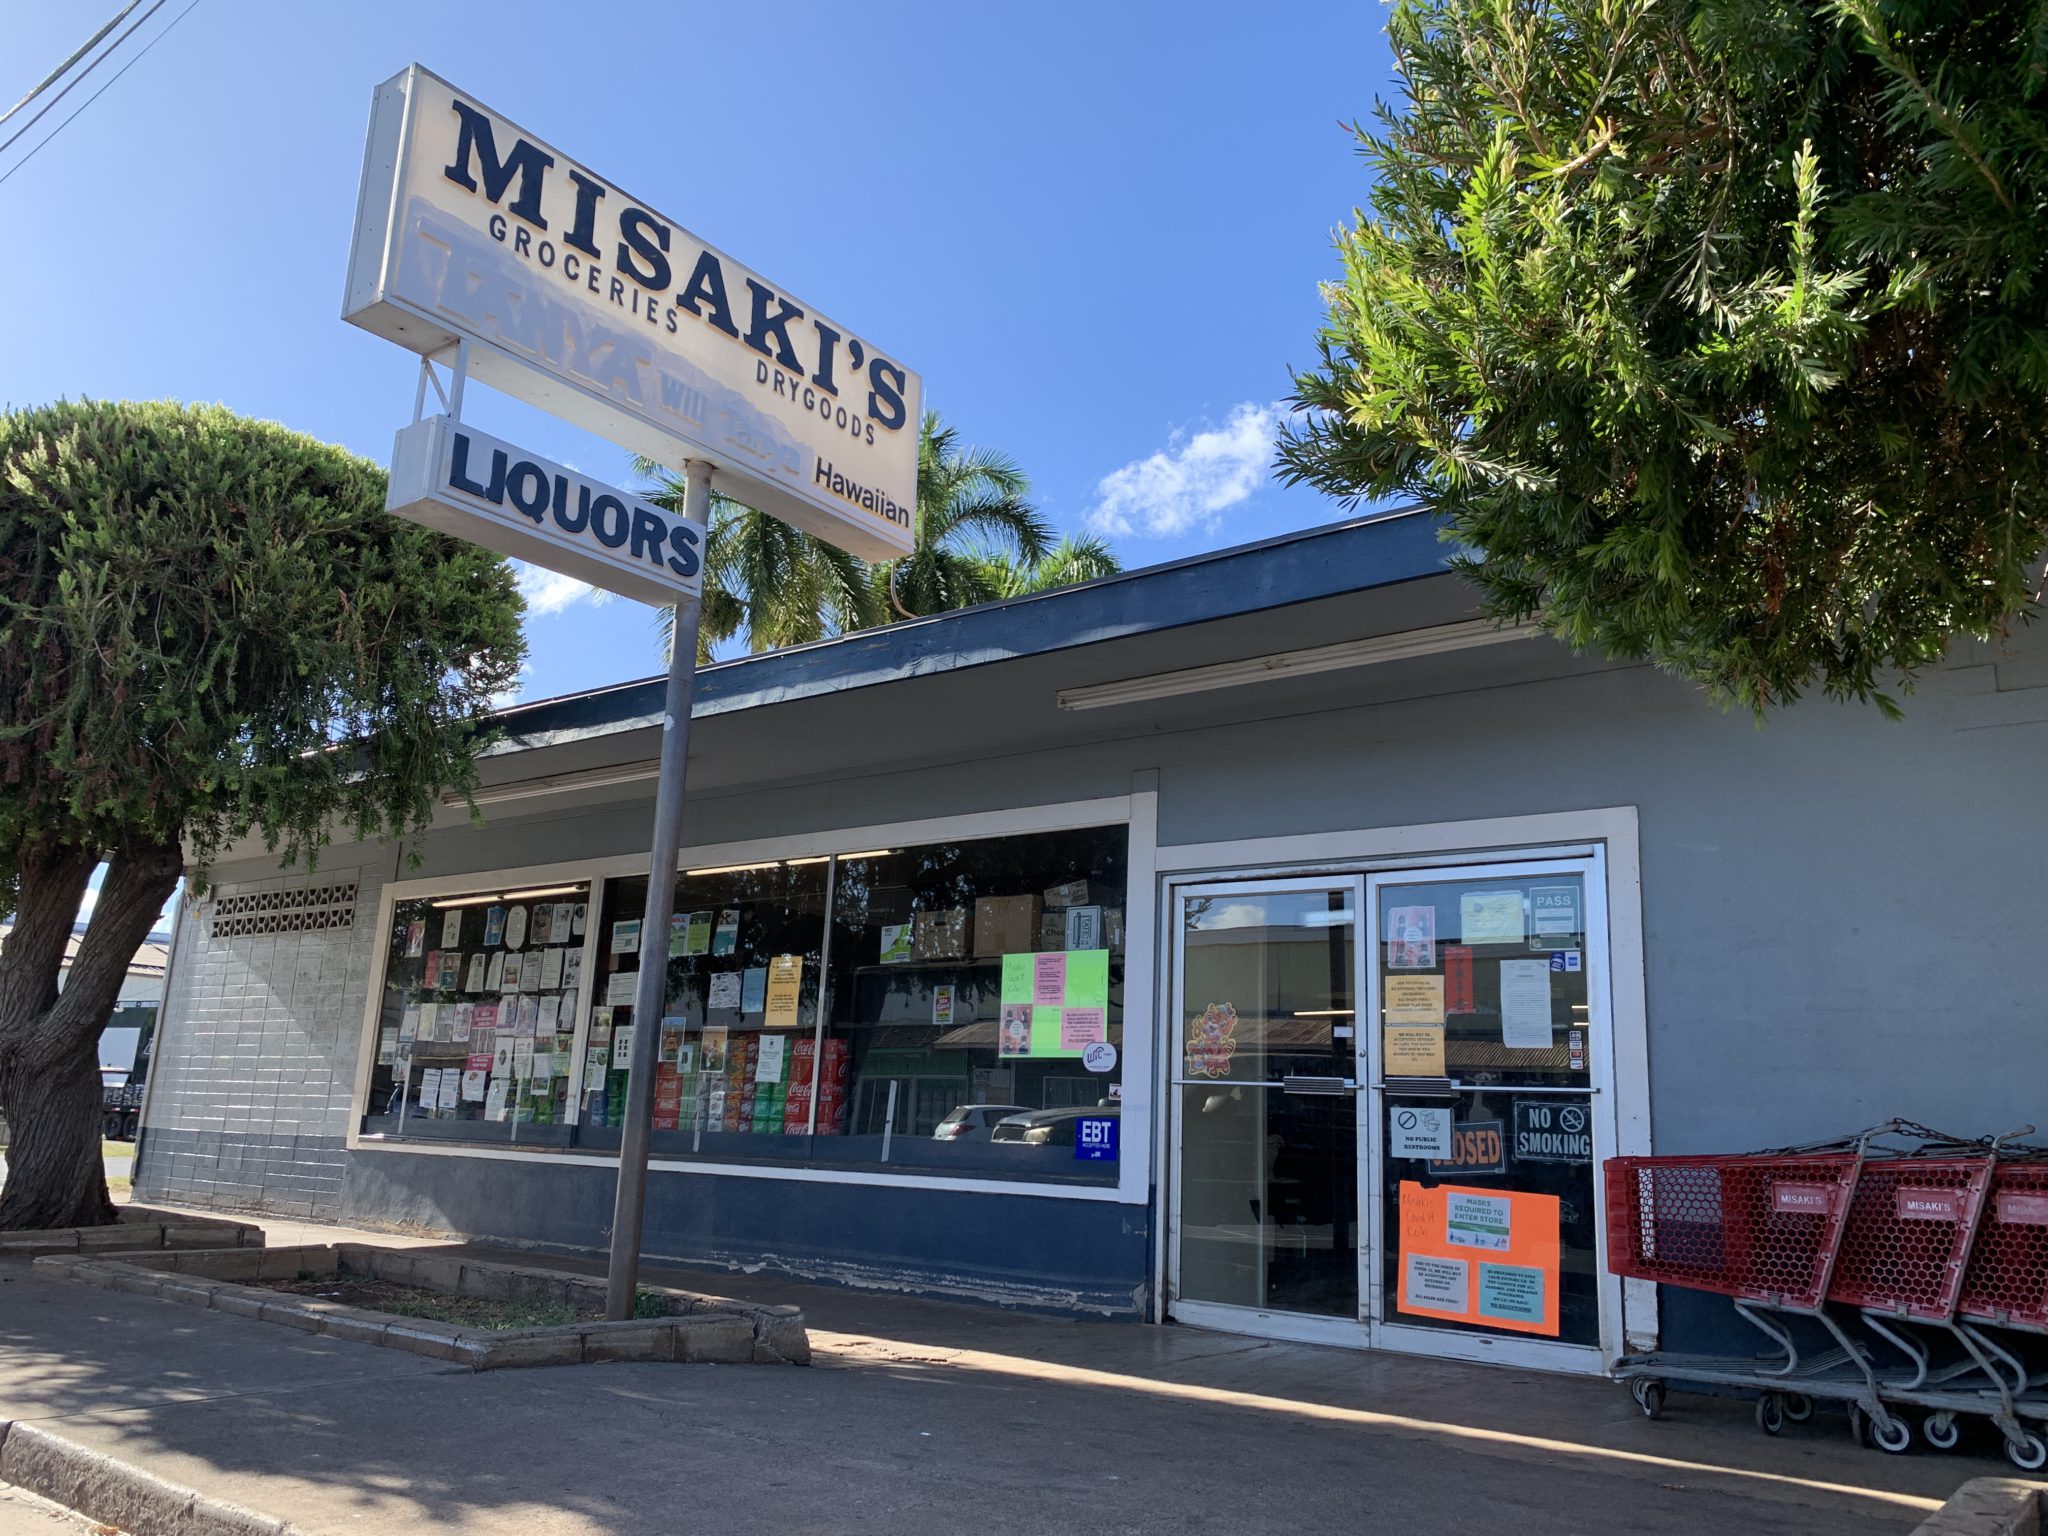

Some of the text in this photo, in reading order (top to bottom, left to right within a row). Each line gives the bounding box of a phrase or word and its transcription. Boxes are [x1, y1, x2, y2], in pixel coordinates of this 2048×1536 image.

[444, 99, 907, 430] MISAKI'S
[489, 213, 678, 334] GROCERIES
[757, 358, 875, 447] DRYGOODS
[814, 457, 910, 530] Hawaiian
[448, 432, 700, 578] LIQUORS
[1536, 895, 1572, 907] PASS
[1529, 1108, 1551, 1129] NO
[1082, 1120, 1112, 1143] EBT
[1519, 1131, 1591, 1156] SMOKING
[1454, 1204, 1492, 1215] REQUIRED
[1466, 1198, 1492, 1207] MASKS
[1780, 1194, 1822, 1205] MISAKI'S
[1907, 1200, 1951, 1212] MISAKI'S
[1454, 1212, 1504, 1224] ENTER STORE
